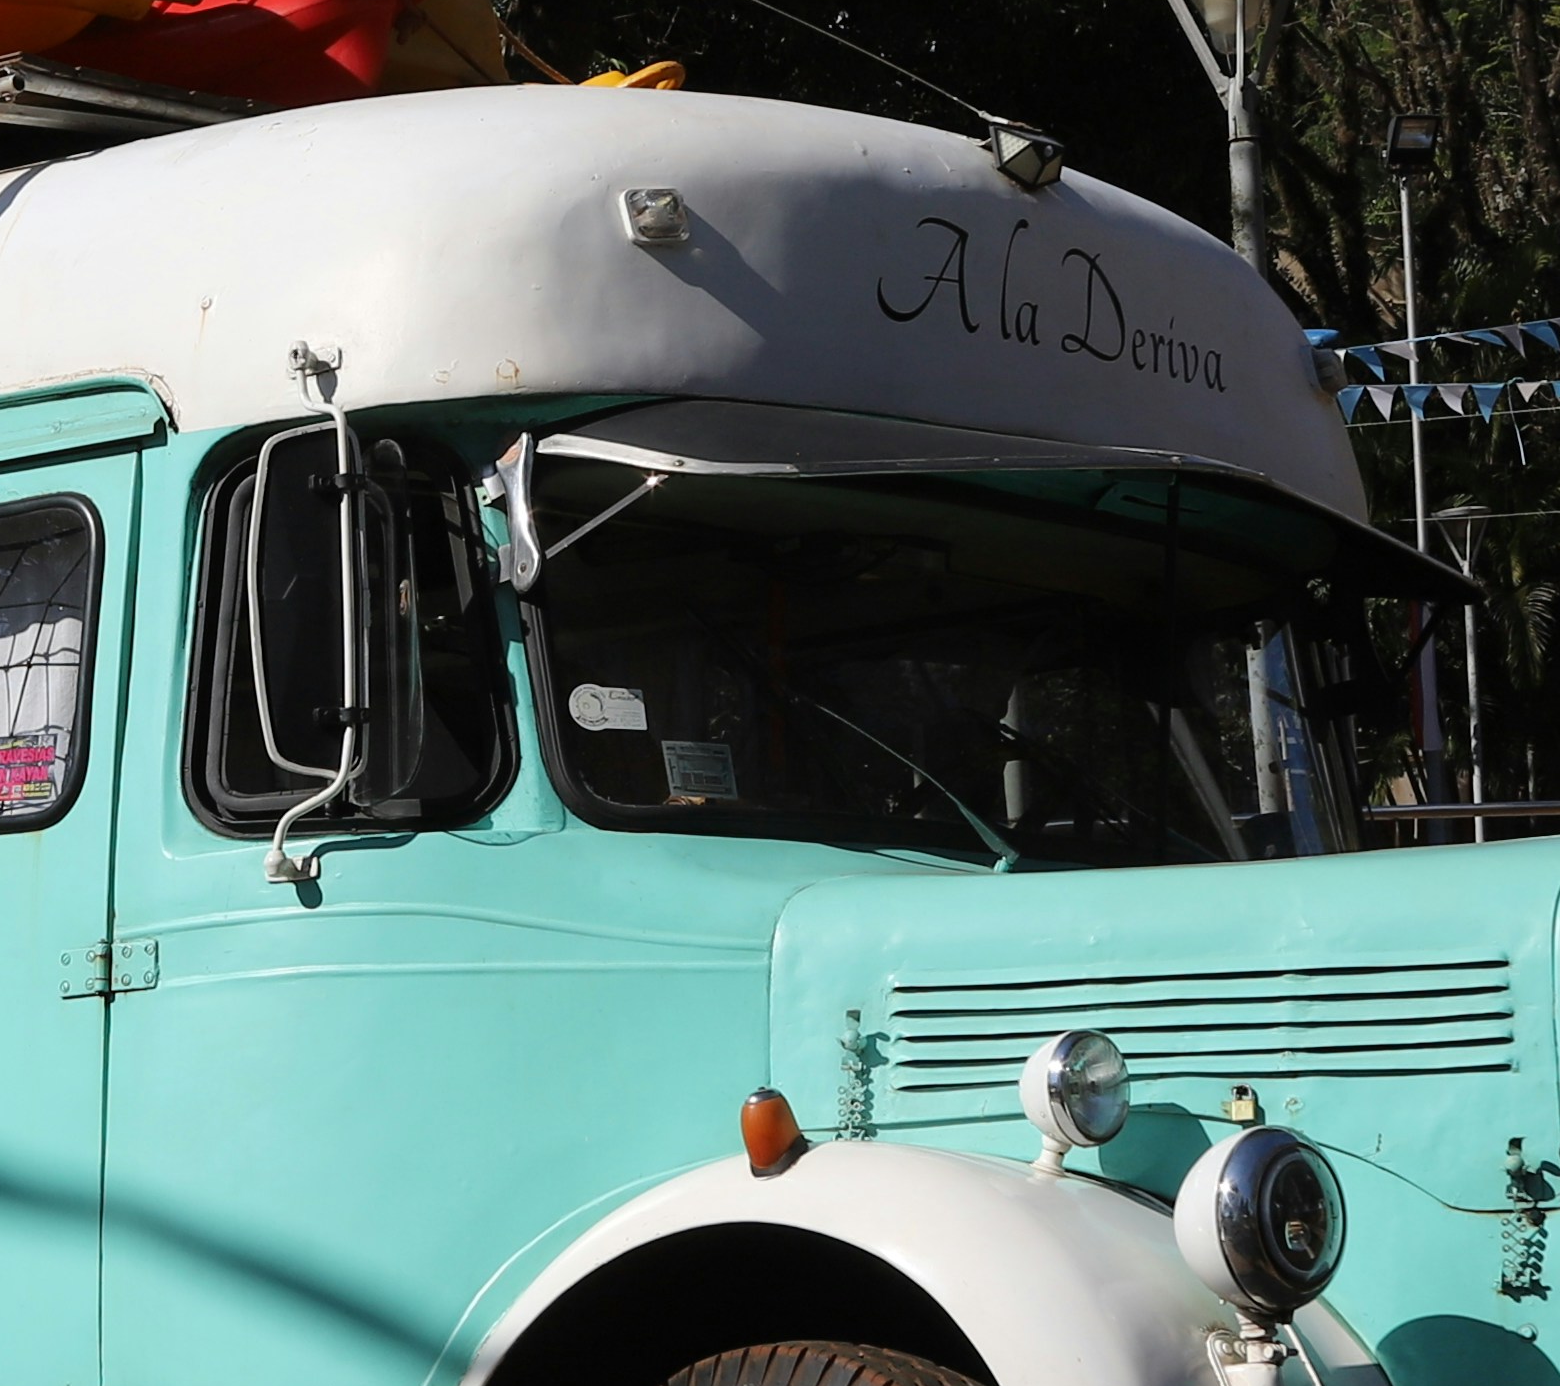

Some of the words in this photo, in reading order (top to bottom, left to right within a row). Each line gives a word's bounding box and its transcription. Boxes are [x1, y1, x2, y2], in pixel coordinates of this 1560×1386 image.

[877, 216, 980, 334] A
[999, 218, 1040, 347] la
[1061, 247, 1228, 394] Deriva
